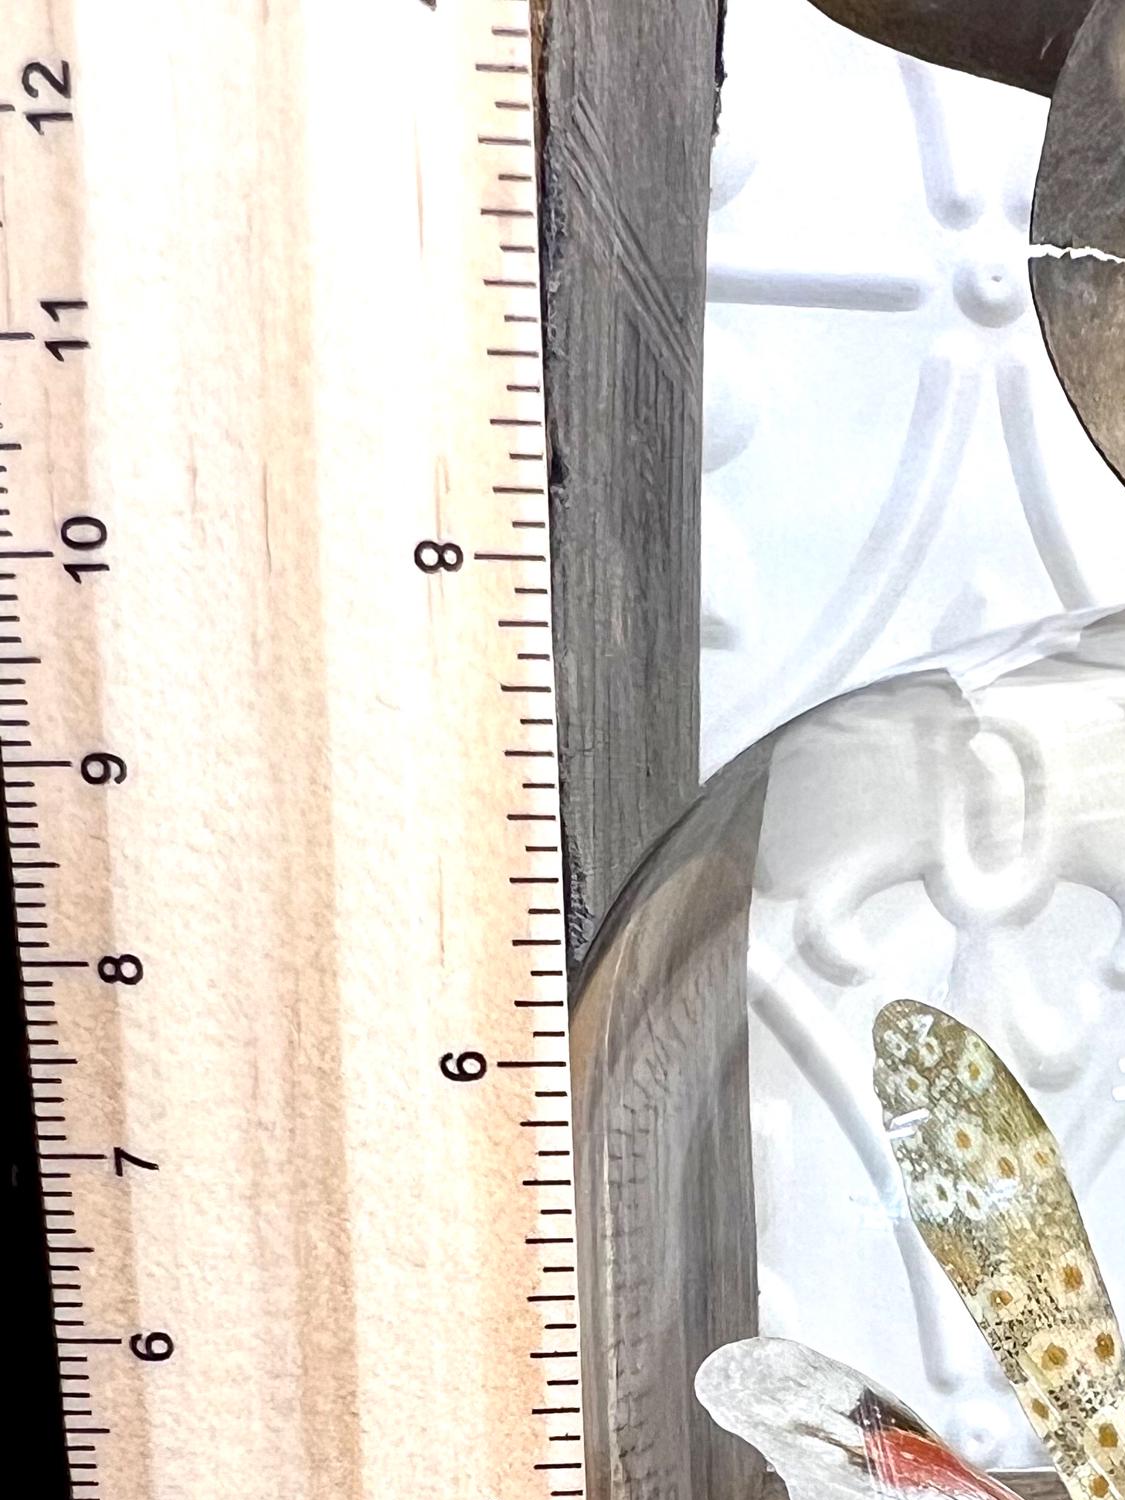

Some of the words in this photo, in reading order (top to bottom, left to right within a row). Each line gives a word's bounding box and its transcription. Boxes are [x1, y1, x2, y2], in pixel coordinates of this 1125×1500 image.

[21, 58, 73, 135] 12
[40, 299, 90, 362] 11
[60, 515, 110, 584] 10
[414, 539, 465, 574] 8
[80, 751, 128, 786] 9
[97, 952, 145, 987] 8
[438, 1050, 489, 1083] 9
[113, 1145, 160, 1178] 7
[128, 1330, 175, 1363] 6
